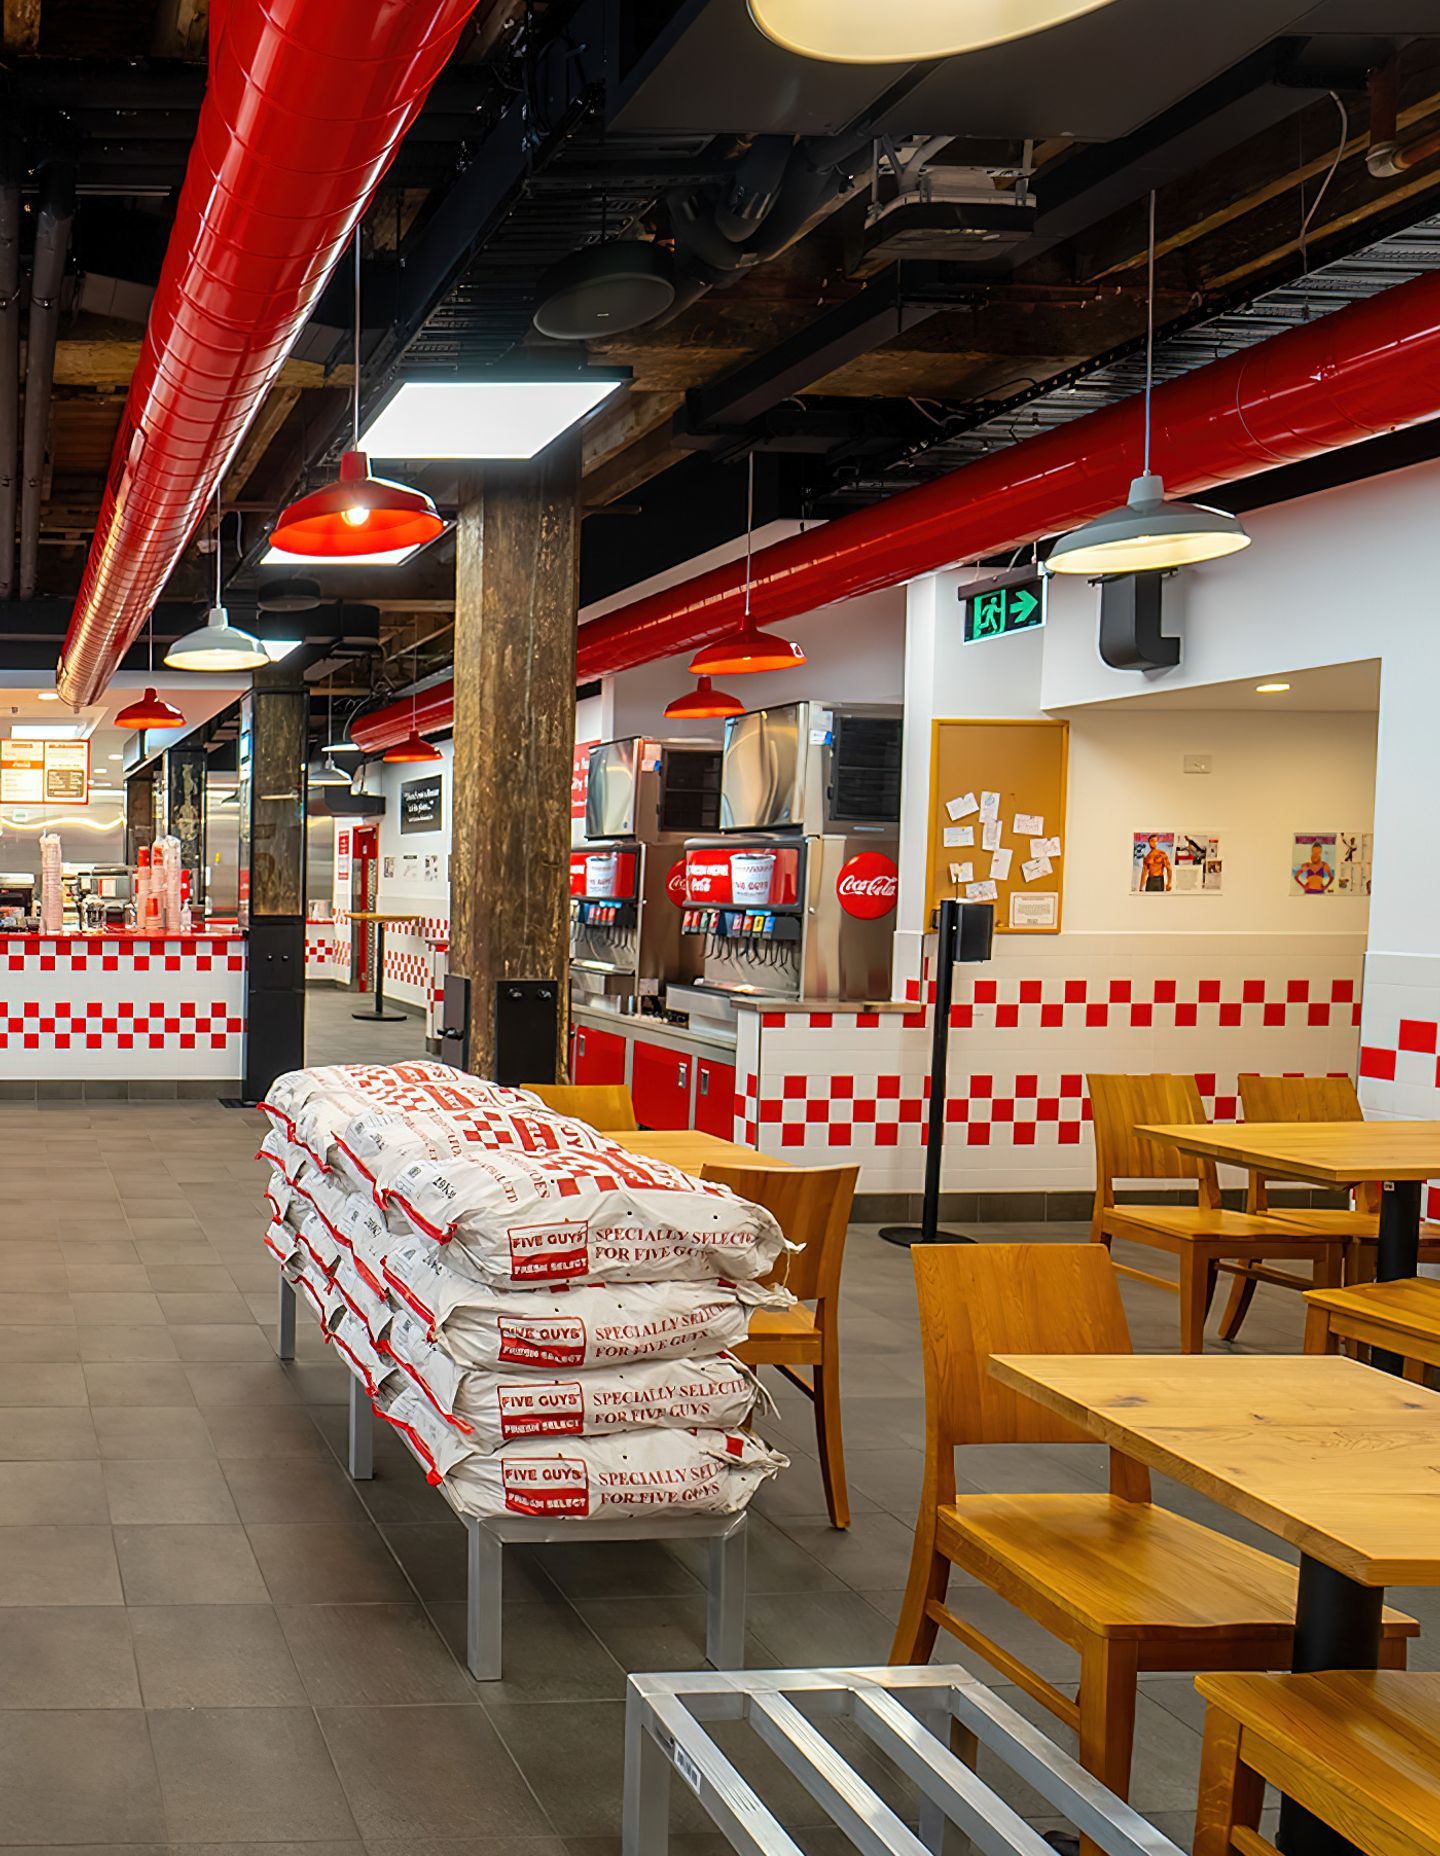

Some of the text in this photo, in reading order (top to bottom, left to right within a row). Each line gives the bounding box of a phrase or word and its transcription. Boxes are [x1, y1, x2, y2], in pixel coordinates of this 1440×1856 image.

[512, 1232, 583, 1248] FIVE GUYS
[595, 1227, 690, 1243] SPECIALLY
[595, 1246, 630, 1262] FOR
[634, 1246, 670, 1261] FIVE
[539, 1327, 581, 1341] GUYS
[595, 1317, 680, 1341] SPECIALLY
[595, 1346, 629, 1358] FOR
[633, 1340, 668, 1356] FIVE
[501, 1393, 578, 1408] FIVE GUYS
[593, 1379, 750, 1406] SPECIALLY SELECTE
[595, 1402, 710, 1425] FOR FIVE GUYS
[504, 1468, 582, 1481] FIVE GUYS
[598, 1467, 687, 1486] SPECIALLY
[600, 1492, 635, 1505] FOR
[639, 1491, 678, 1504] FIVE
